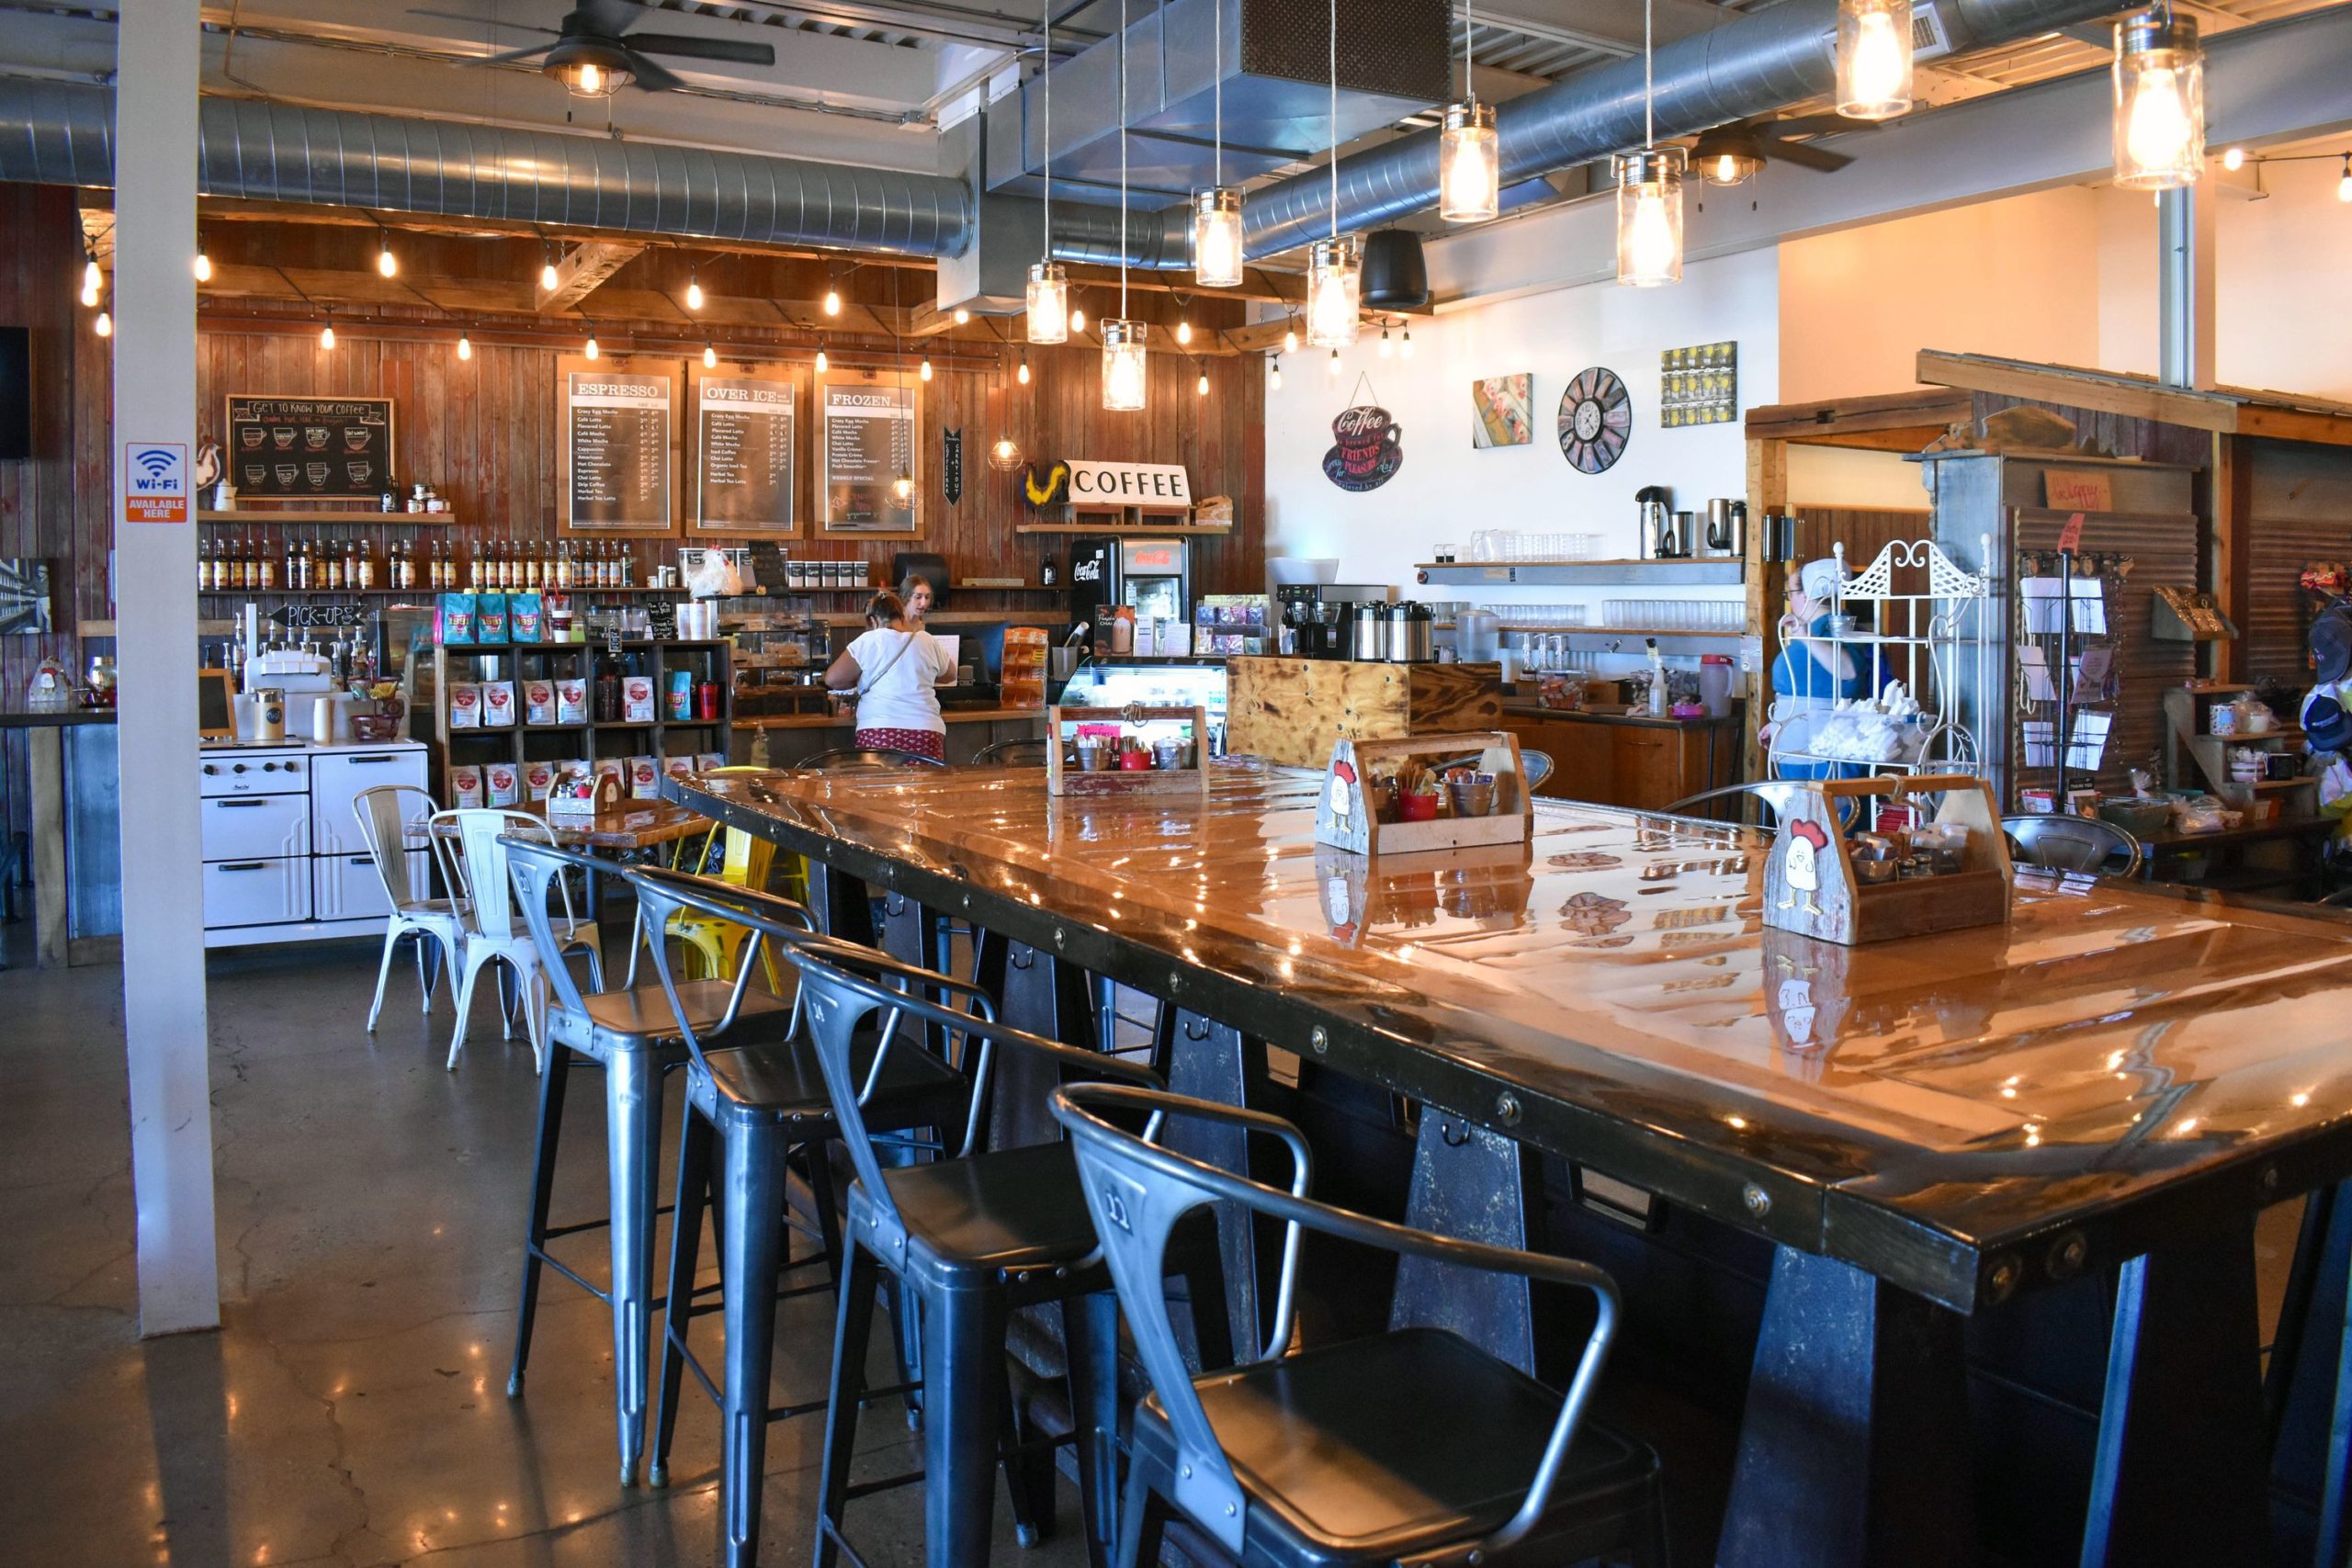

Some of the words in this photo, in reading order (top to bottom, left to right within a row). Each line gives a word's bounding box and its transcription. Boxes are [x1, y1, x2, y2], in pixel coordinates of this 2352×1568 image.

[577, 384, 658, 397] ESPRESSO
[707, 388, 748, 400] OVER
[753, 390, 777, 402] ICE
[832, 394, 891, 406] FROZEN
[278, 403, 288, 412] TO
[290, 404, 313, 413] KNOW
[316, 404, 333, 413] YOUR
[1337, 407, 1383, 436] Coffee
[1341, 445, 1380, 461] FRIENDS
[136, 479, 178, 489] Wi-Fi
[1075, 470, 1183, 497] COFFEE
[129, 500, 184, 509] AVAILABLE
[144, 509, 170, 518] HERE
[288, 607, 342, 626] PICK-UP
[449, 617, 470, 625] 1991
